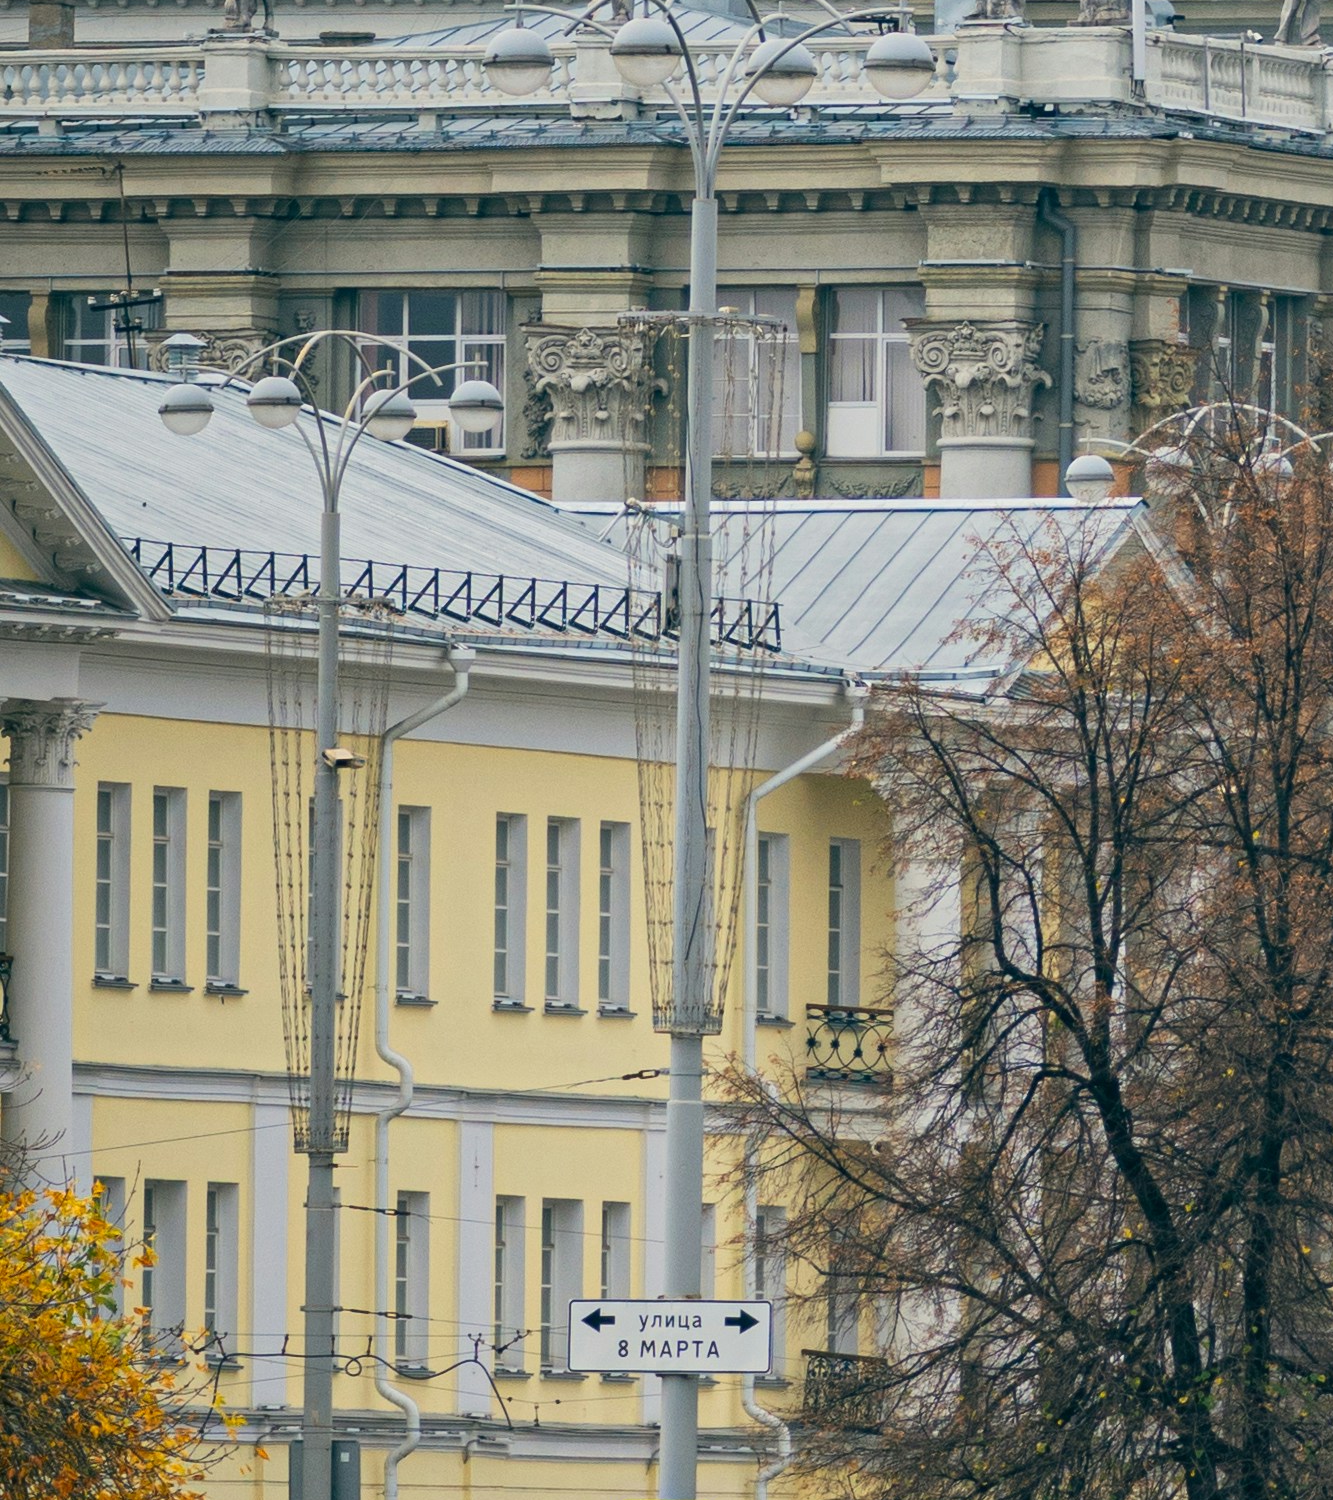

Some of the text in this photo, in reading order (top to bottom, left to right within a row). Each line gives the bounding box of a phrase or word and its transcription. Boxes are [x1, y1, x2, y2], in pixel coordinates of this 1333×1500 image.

[639, 1314, 702, 1332] улица
[618, 1340, 720, 1358] 8 МАРТА
